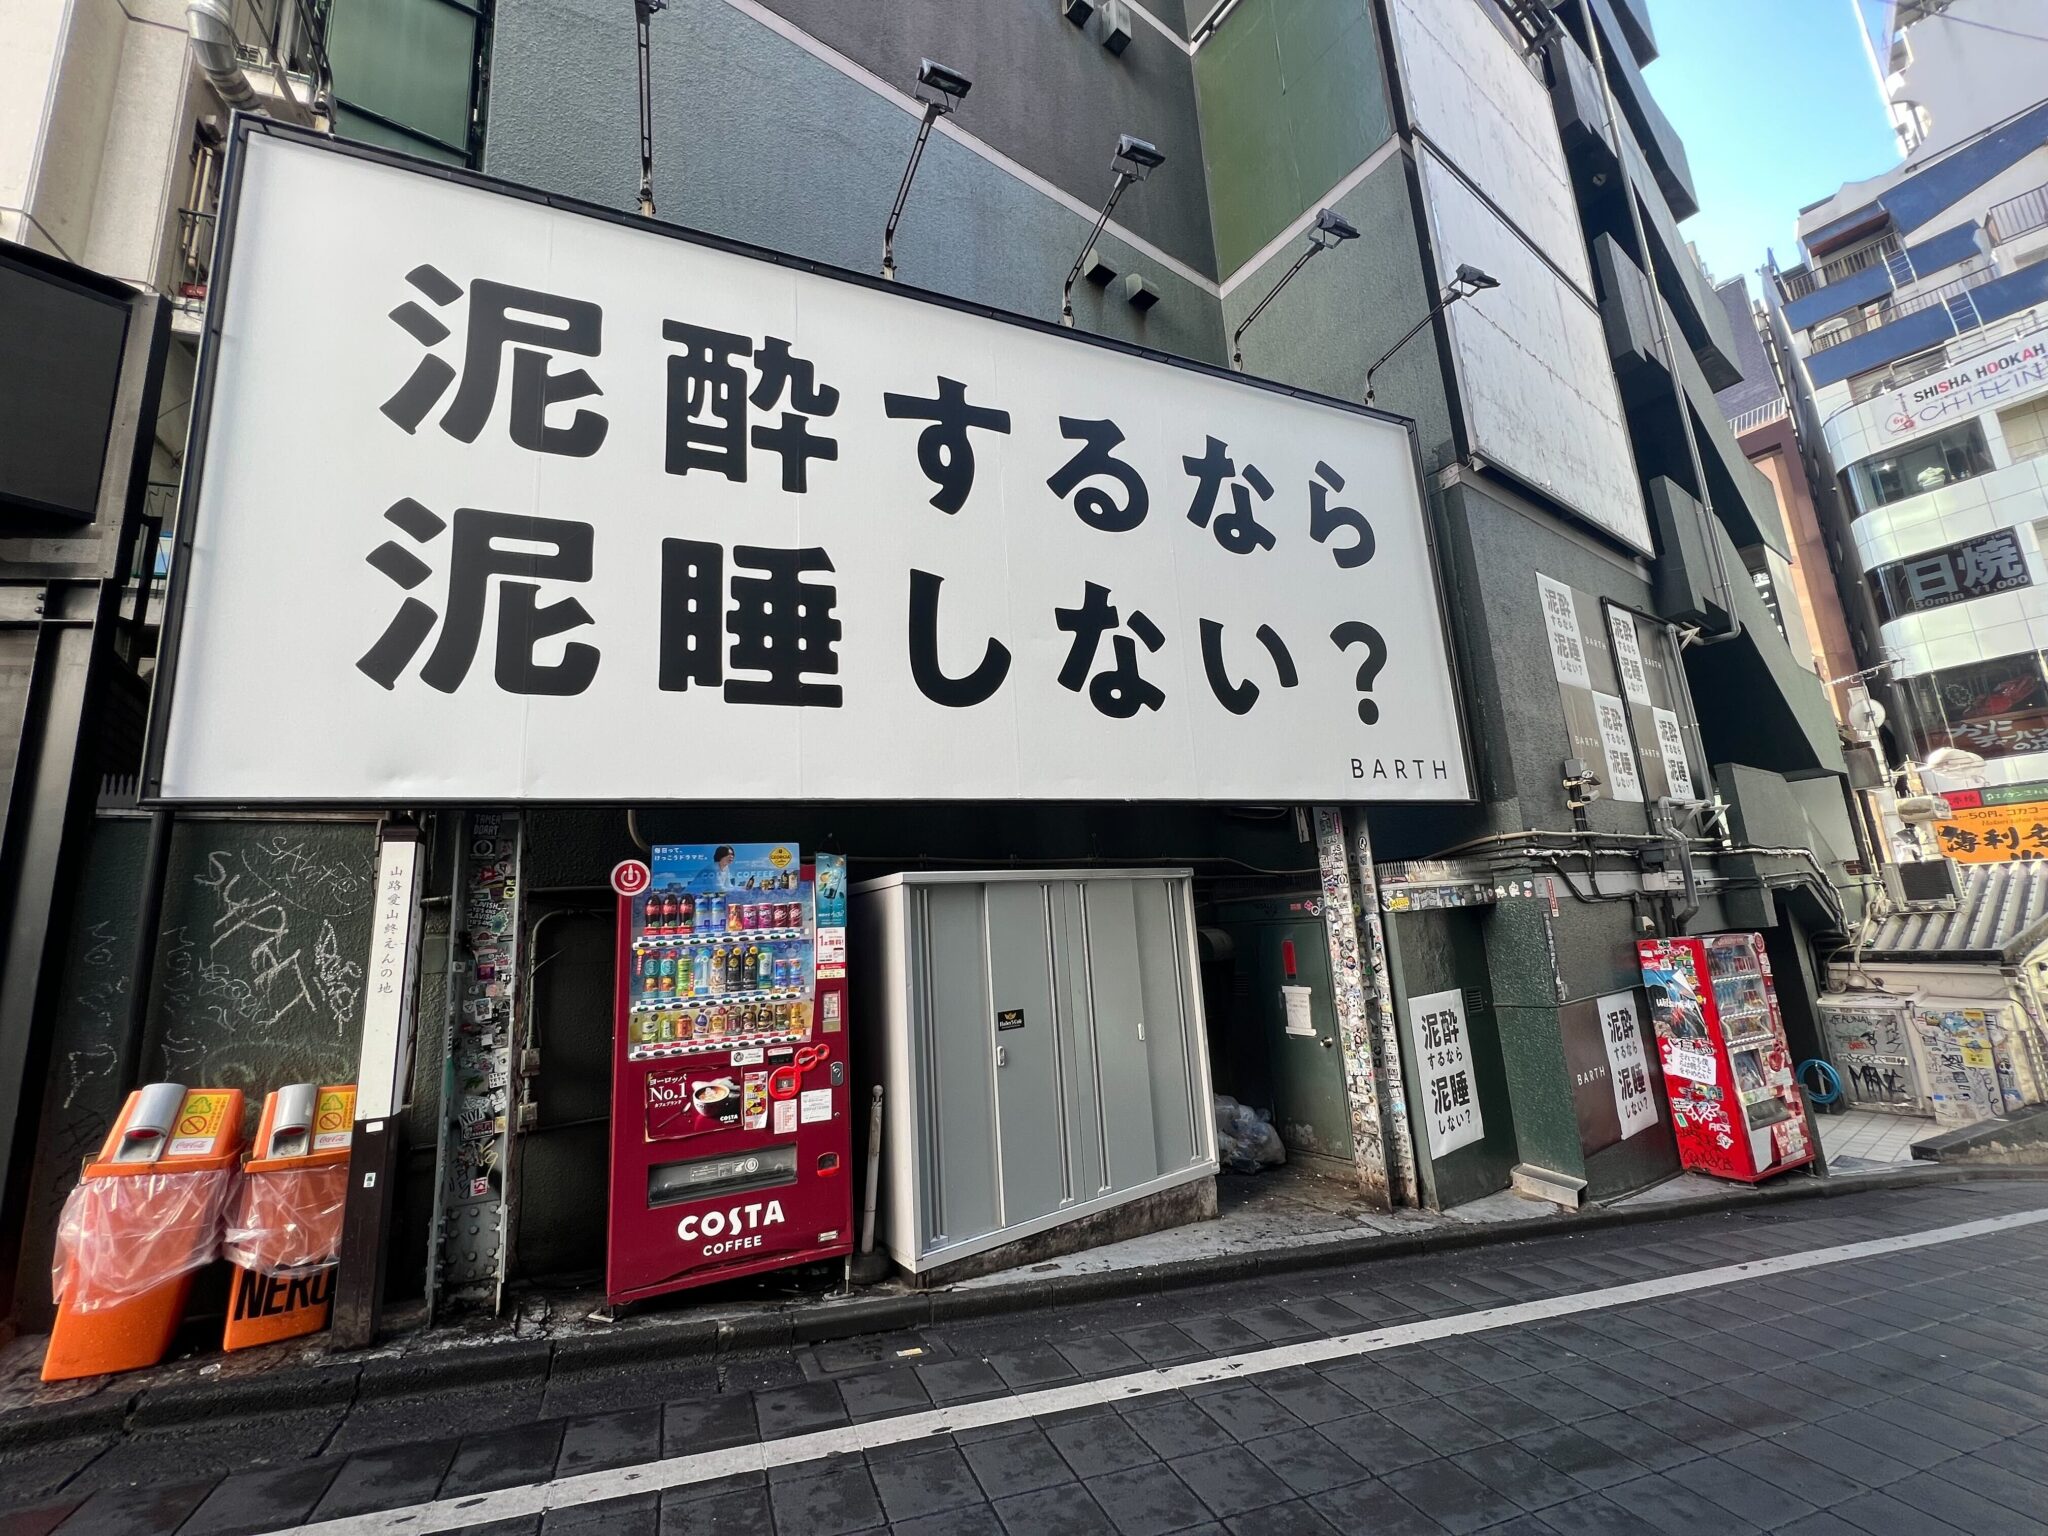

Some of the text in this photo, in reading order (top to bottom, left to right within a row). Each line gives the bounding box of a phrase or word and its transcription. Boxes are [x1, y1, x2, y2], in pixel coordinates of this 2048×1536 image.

[1914, 373, 1972, 402] SHISHA
[1975, 343, 2046, 379] HOOKAH
[379, 264, 1375, 568] 泥酔するなら
[1903, 537, 2023, 602] 日焼
[355, 497, 1387, 726] 泥睡しない？
[1914, 591, 1965, 610] 30min
[1584, 635, 1607, 651] BARTH
[1643, 657, 1663, 669] BARTH
[1574, 735, 1600, 747] BARTH
[1640, 747, 1661, 758] BARTH
[1350, 758, 1447, 780] BARTH
[377, 866, 403, 994] 山路愛山終えんの地
[1421, 1009, 1460, 1050] 泥酔
[1607, 1008, 1634, 1043] 泥酔
[1427, 1047, 1463, 1070] するなら
[1613, 1041, 1638, 1062] するなら
[649, 1073, 688, 1086] ヨーロッパ
[1576, 1065, 1606, 1086] BARTH
[1618, 1062, 1646, 1101] 泥睡
[649, 1082, 688, 1103] No.1
[1431, 1070, 1471, 1115] 泥睡
[719, 1113, 739, 1122] COSTA
[1624, 1096, 1649, 1119] しない？
[1438, 1109, 1471, 1135] しない？
[677, 1199, 785, 1241] COSTA
[702, 1234, 762, 1257] COFFEE
